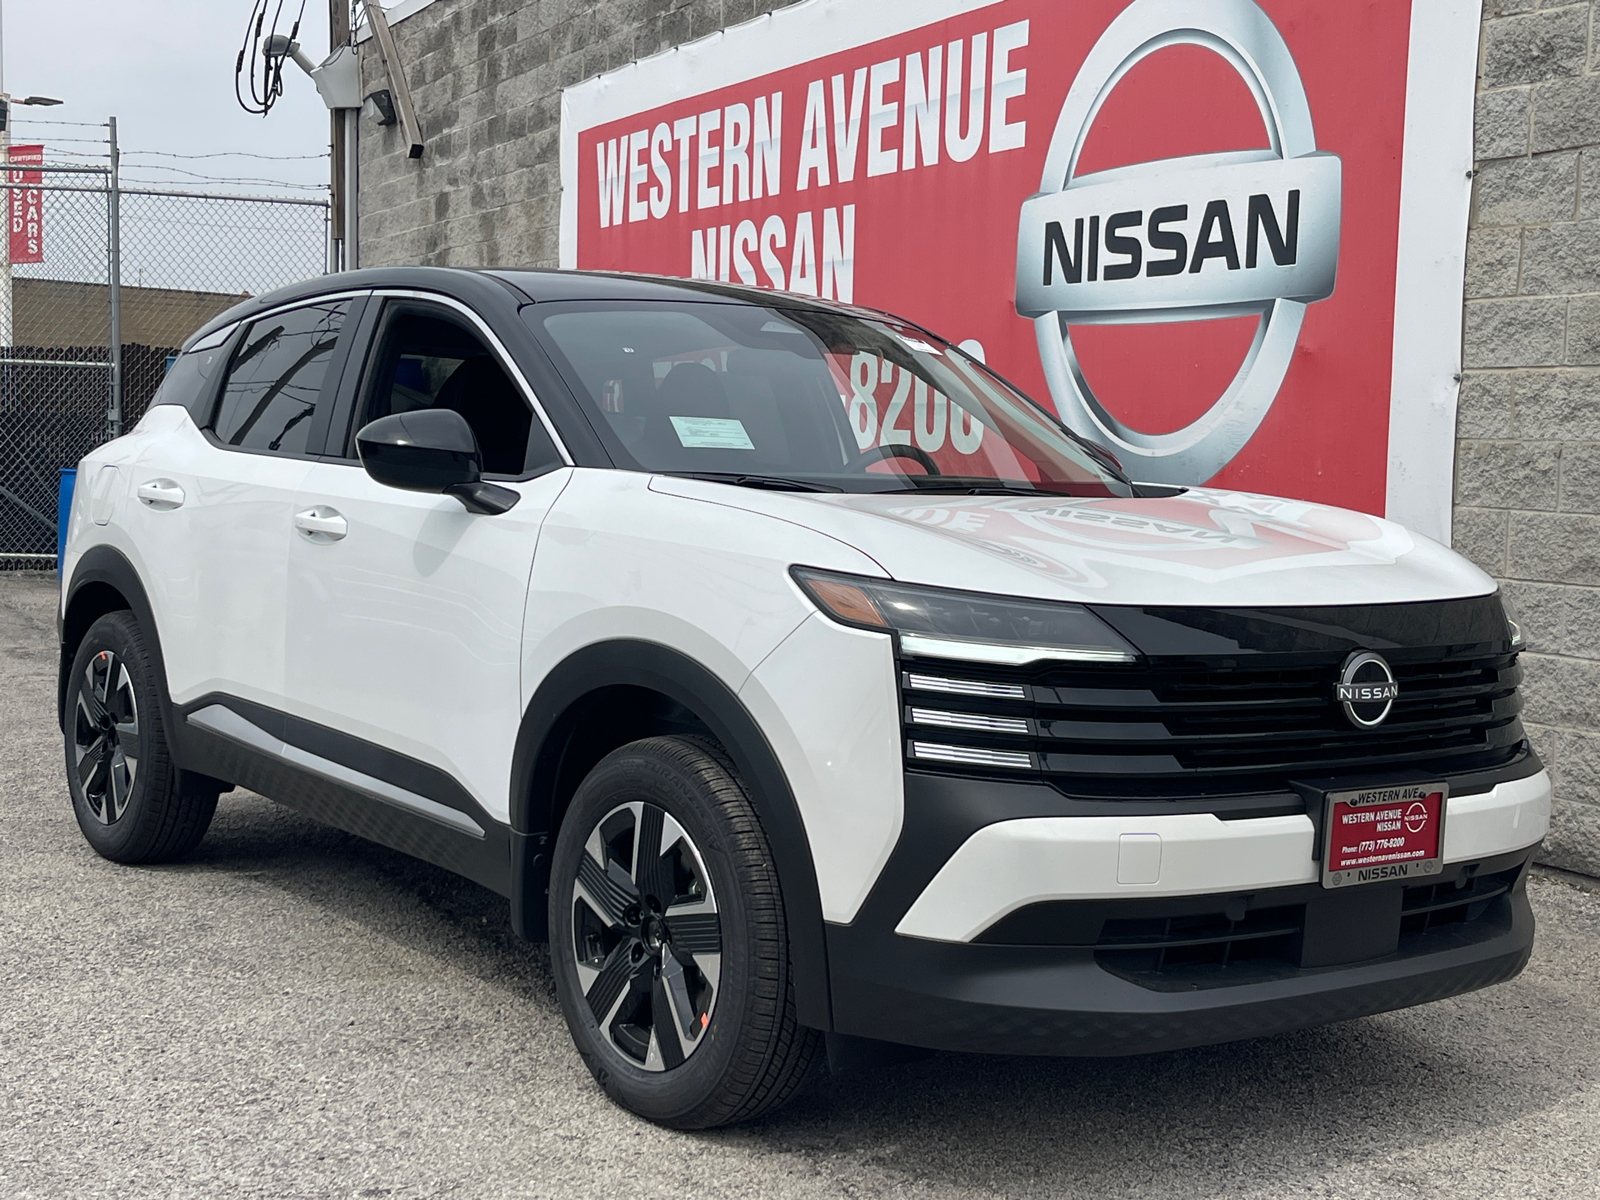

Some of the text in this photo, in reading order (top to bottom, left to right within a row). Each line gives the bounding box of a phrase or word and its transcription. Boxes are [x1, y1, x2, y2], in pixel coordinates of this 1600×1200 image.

[596, 19, 1030, 229] WESTERN AVENUE
[9, 154, 42, 163] CERTIFIED
[12, 169, 24, 233] USED
[26, 188, 39, 254] CARS
[1043, 189, 1301, 286] NISSAN
[691, 204, 855, 304] NISSAN
[1340, 685, 1398, 700] NISSAN
[1358, 789, 1401, 804] WESTERN
[1342, 808, 1402, 824] WESTERN AVENUE
[1376, 820, 1401, 832] NISSAN
[1341, 837, 1405, 854] Phone: (773) 776-8200
[1340, 850, 1425, 866] www.westernavenissan.com
[1358, 864, 1408, 882] NISSAN
